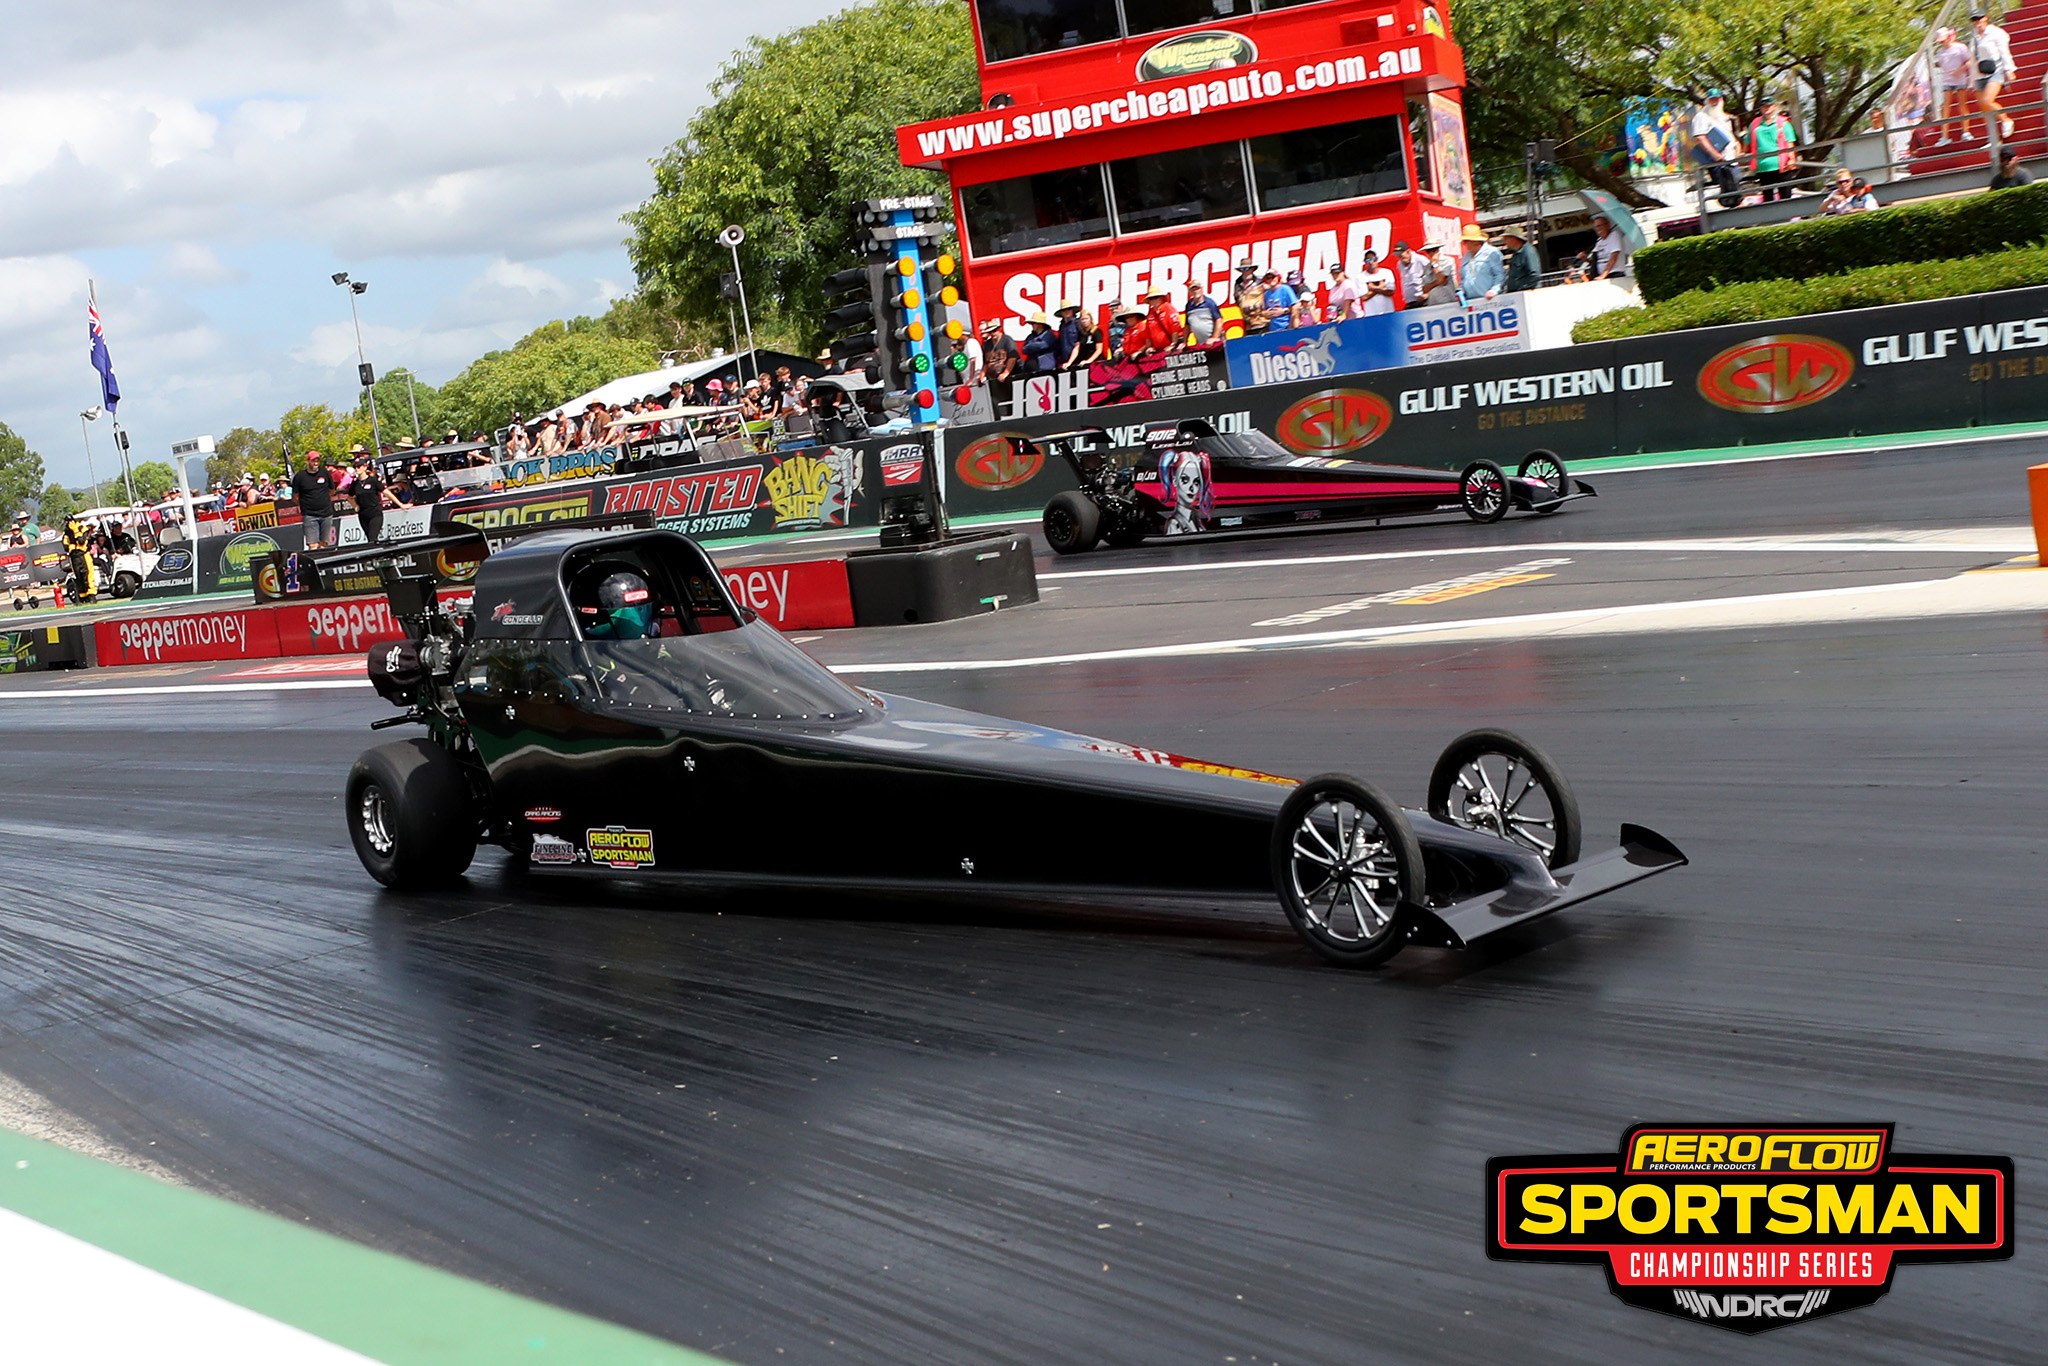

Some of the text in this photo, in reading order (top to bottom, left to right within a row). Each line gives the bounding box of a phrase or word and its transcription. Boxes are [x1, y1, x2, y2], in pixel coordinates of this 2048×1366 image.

[917, 46, 1422, 157] www.supercheapauto.com.au
[880, 196, 934, 210] PRE-STAGE
[895, 226, 926, 238] STAGE
[1002, 217, 1392, 341] SUPERCHEAP
[1452, 348, 1474, 359] Parts
[1864, 328, 1958, 366] GULF
[1250, 345, 1319, 385] Diesel
[1399, 361, 1674, 416] GULF WESTERN OIL
[1218, 410, 1258, 434] OIL
[1478, 403, 1587, 430] GO THE DISTANCE
[1145, 428, 1177, 442] 9012
[549, 447, 617, 481] BROS
[764, 457, 833, 500] BANG
[604, 465, 762, 522] BOOSTED
[774, 493, 825, 523] SHIFT
[387, 521, 424, 541] Breakers
[690, 513, 753, 534] SYSTEMS
[120, 614, 246, 661] peppermoney
[589, 832, 650, 848] AEROFLOW
[592, 848, 653, 862] SPORTSMAN
